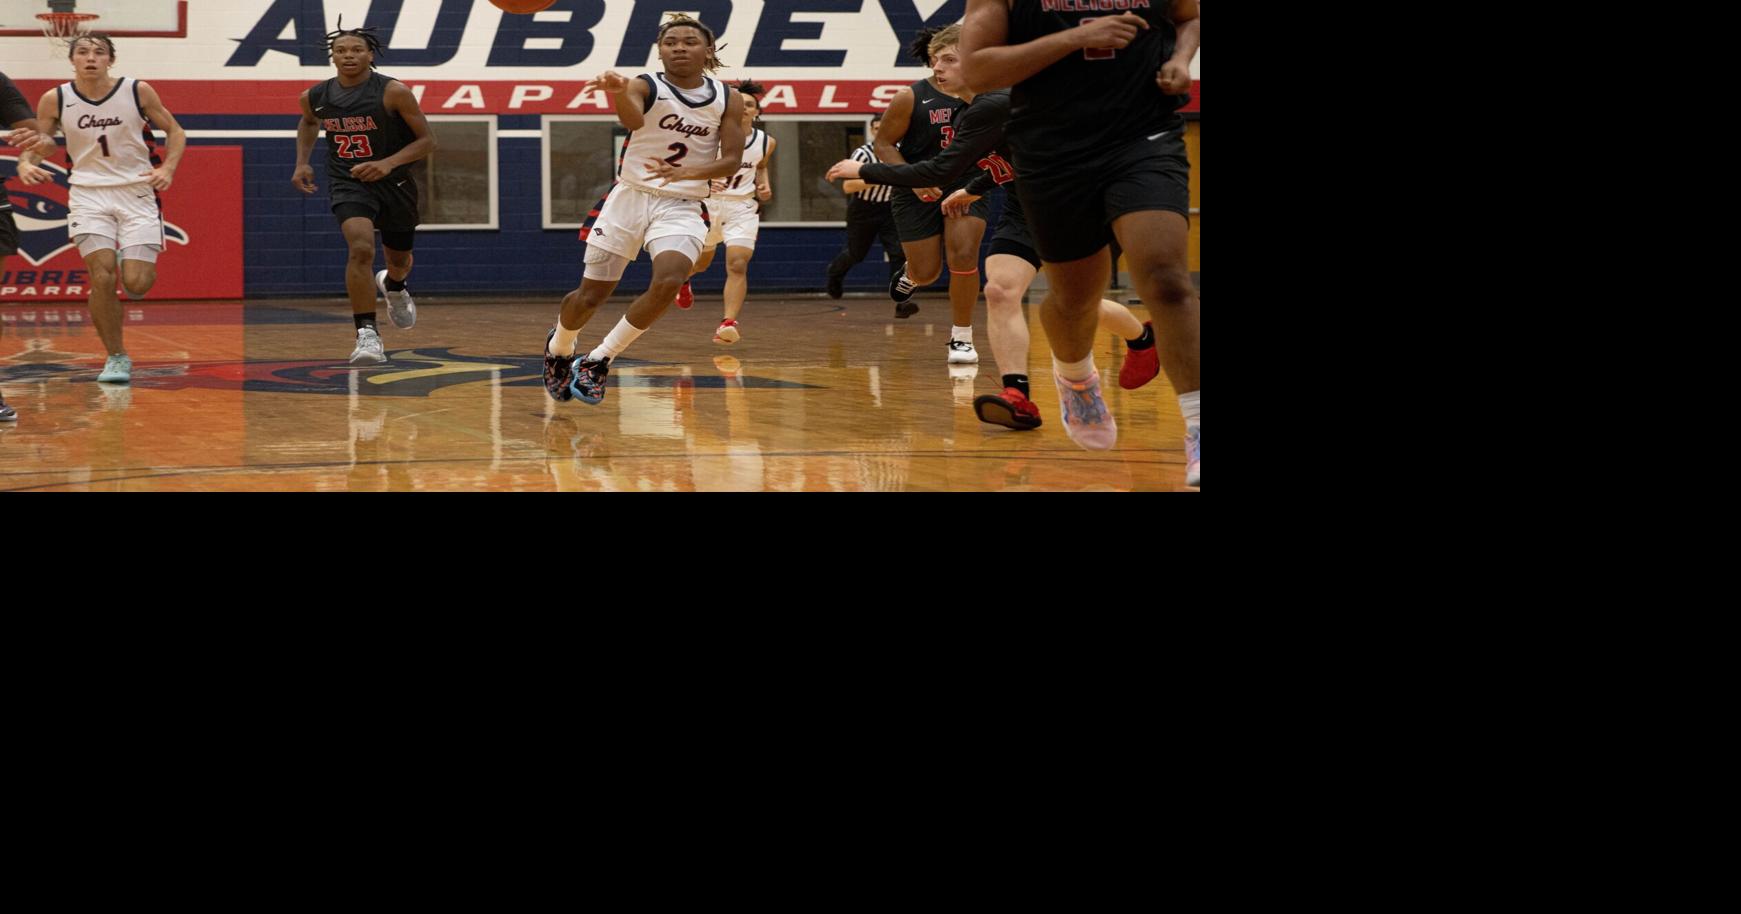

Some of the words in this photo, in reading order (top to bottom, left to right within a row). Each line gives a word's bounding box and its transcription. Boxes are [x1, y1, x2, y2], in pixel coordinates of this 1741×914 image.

[225, 0, 967, 67] AUBREY
[417, 85, 911, 109] APAALS
[78, 114, 123, 130] Chaps
[658, 114, 710, 138] Chaps
[97, 134, 110, 157] 1
[334, 134, 373, 158] 23
[664, 142, 688, 167] 2
[0, 286, 122, 295] PARR
